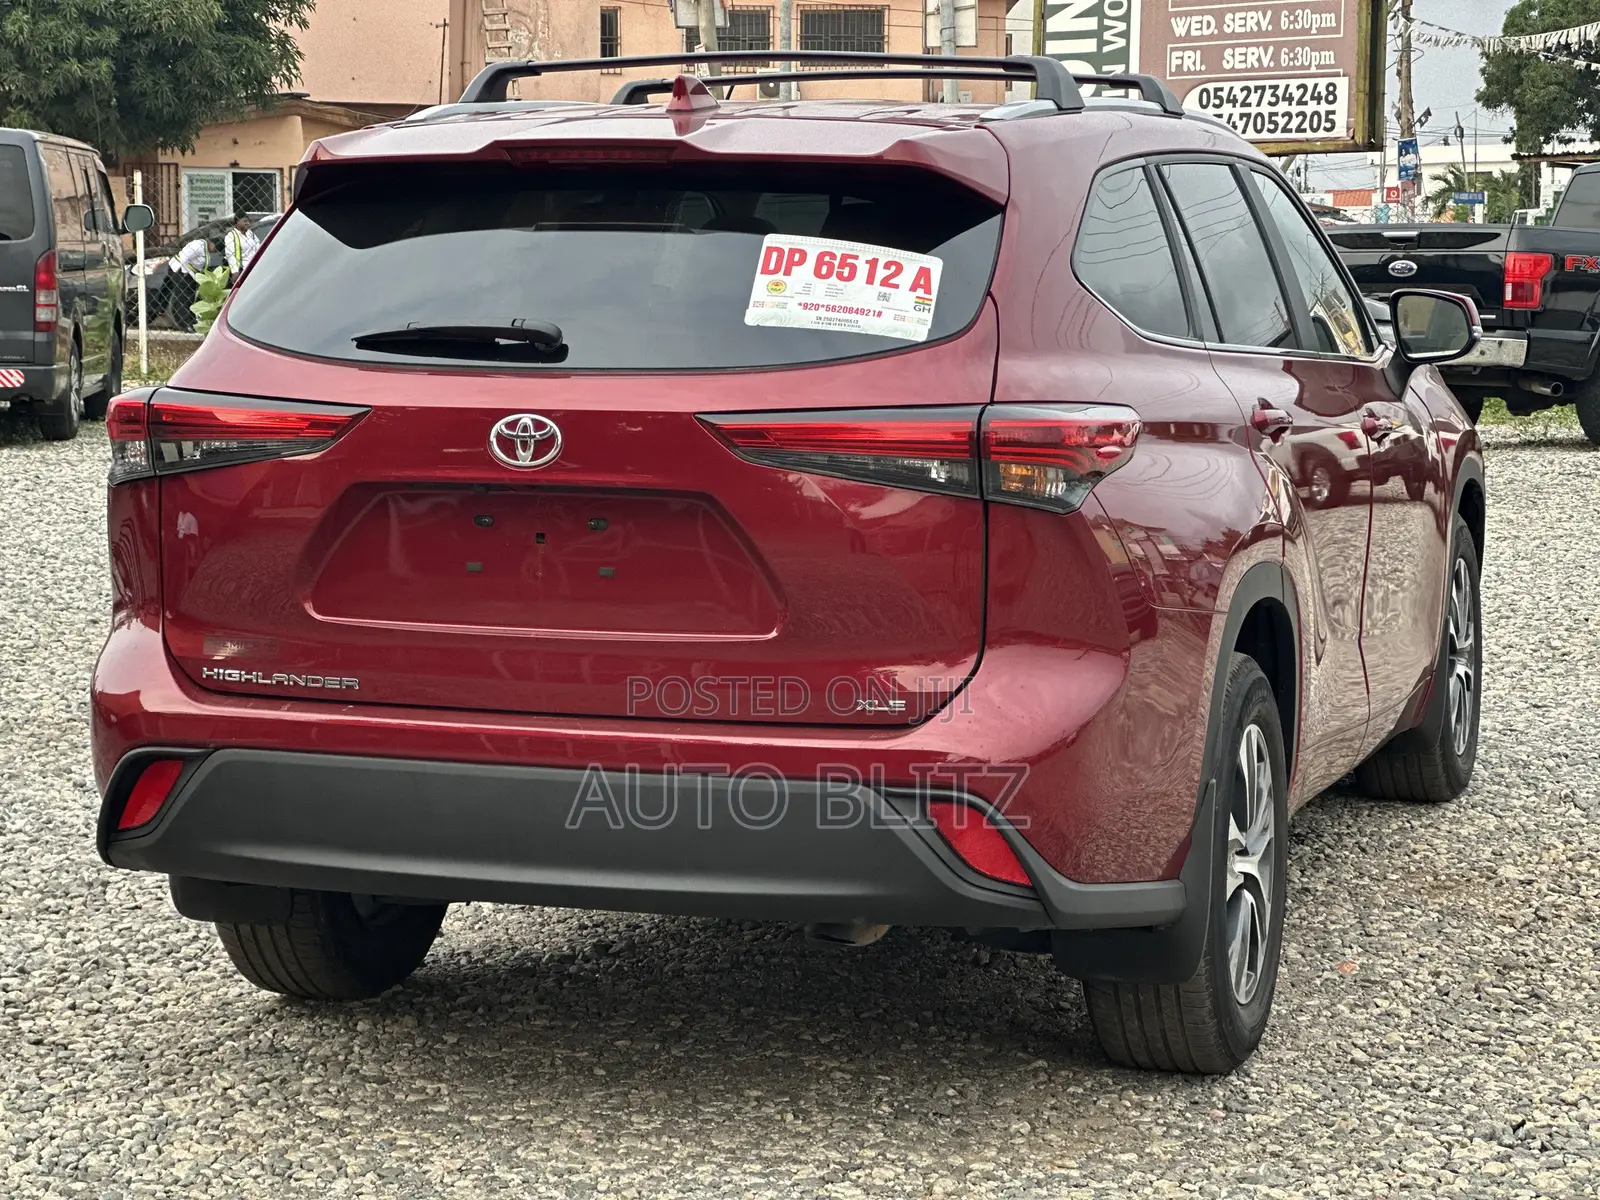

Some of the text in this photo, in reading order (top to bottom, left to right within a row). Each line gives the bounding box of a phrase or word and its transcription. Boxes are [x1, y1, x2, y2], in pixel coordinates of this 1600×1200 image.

[1170, 9, 1336, 37] WED. SERV. 6:30pm
[1170, 46, 1335, 73] FRI. SERV. 6:30pm
[1198, 82, 1338, 109] 0542734248
[1212, 110, 1337, 135] 47052205
[760, 246, 933, 295] DP 6512 A
[1565, 254, 1600, 272] FX
[913, 304, 932, 314] GH
[202, 667, 360, 690] HIGHLANDER
[856, 699, 906, 711] XLE
